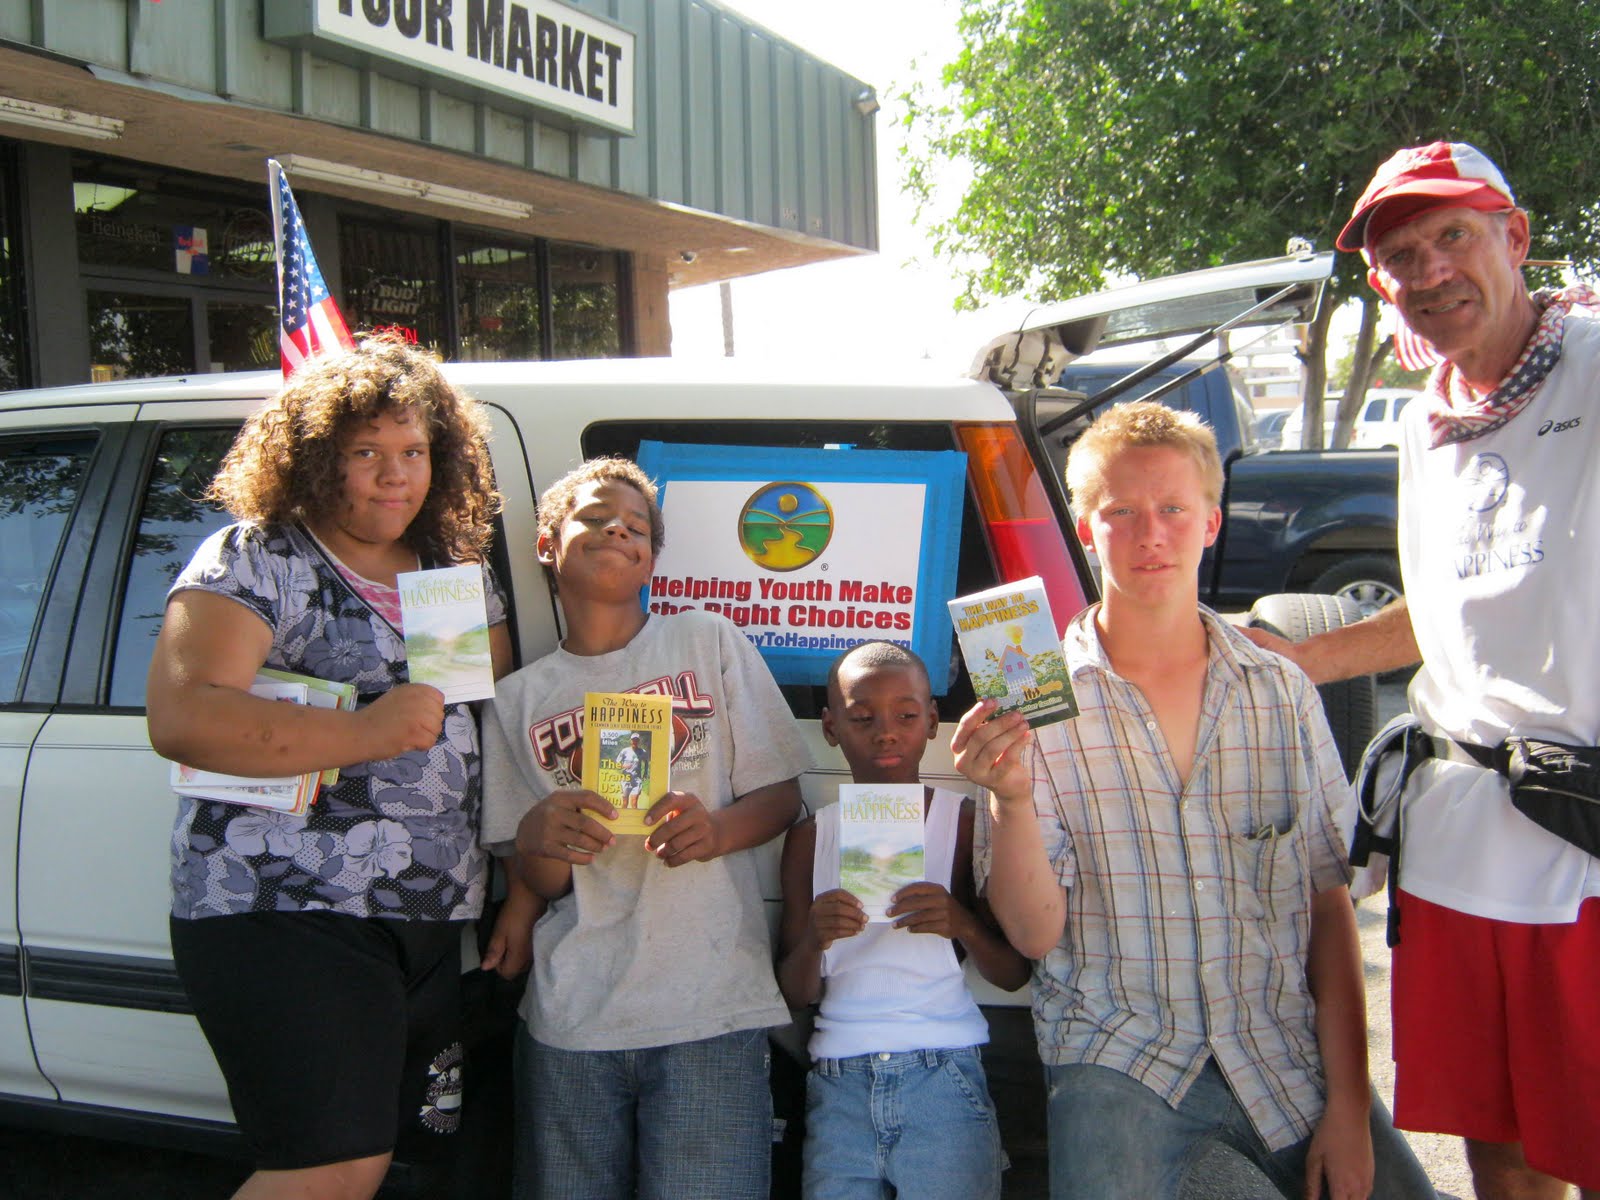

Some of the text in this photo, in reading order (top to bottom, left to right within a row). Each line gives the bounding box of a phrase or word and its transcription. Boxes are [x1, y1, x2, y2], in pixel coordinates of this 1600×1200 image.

[338, 0, 622, 107] UR MARKET
[378, 284, 415, 300] BUD
[372, 297, 421, 316] LIGHT
[1553, 416, 1582, 433] asics
[1454, 540, 1545, 579] APPINESS
[402, 582, 481, 608] HAPPINESS
[651, 576, 913, 604] Helping Youth Make
[962, 593, 1025, 616] THE WAY TO
[650, 602, 696, 616] th
[788, 604, 912, 630] Choices
[958, 600, 1040, 633] HAPPINESS
[602, 697, 617, 707] The
[621, 697, 639, 709] Way
[590, 706, 663, 724] HAPPINESS
[602, 738, 618, 746] Miles
[601, 758, 622, 769] The
[601, 771, 632, 782] Trans
[600, 782, 623, 794] USA
[843, 800, 921, 820] HAPPINESS
